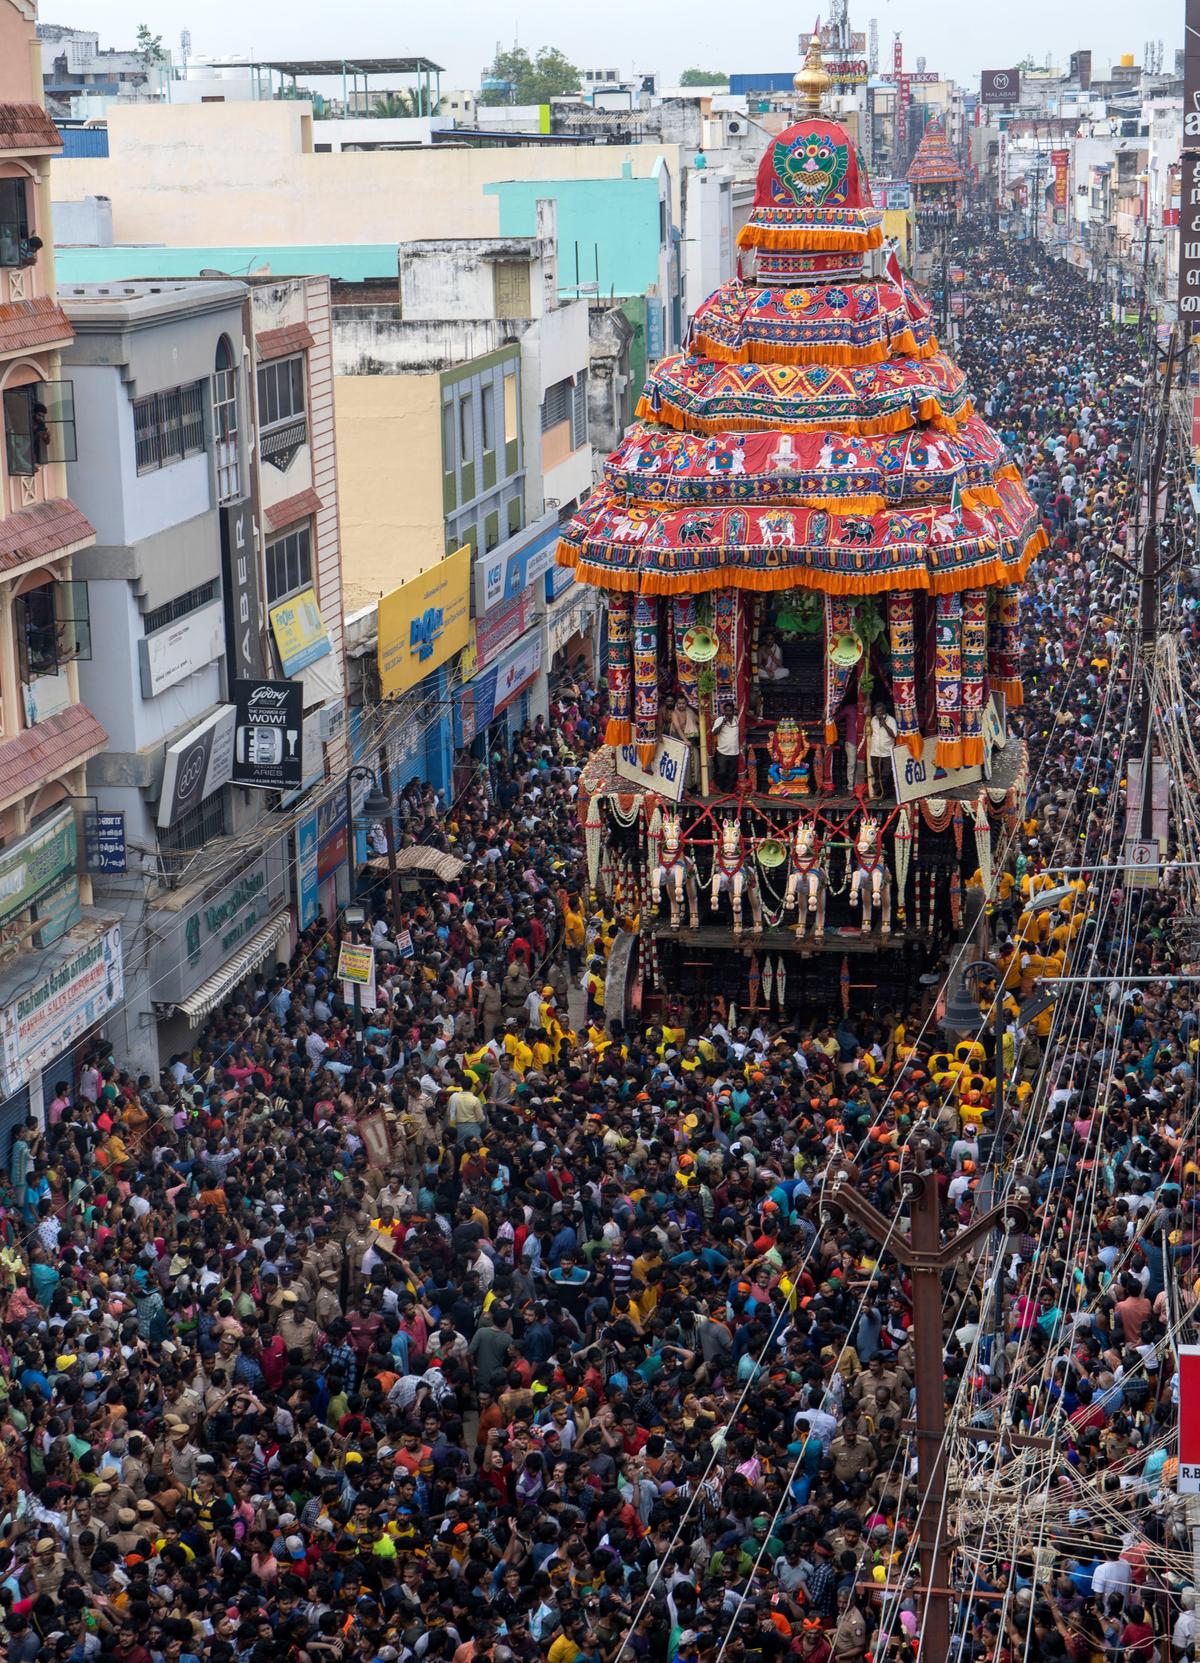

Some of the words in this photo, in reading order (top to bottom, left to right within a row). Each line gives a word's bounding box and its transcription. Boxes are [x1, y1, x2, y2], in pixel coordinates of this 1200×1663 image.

[248, 686, 289, 707] Godrej
[249, 714, 286, 724] WOW!
[253, 769, 283, 777] ARIES
